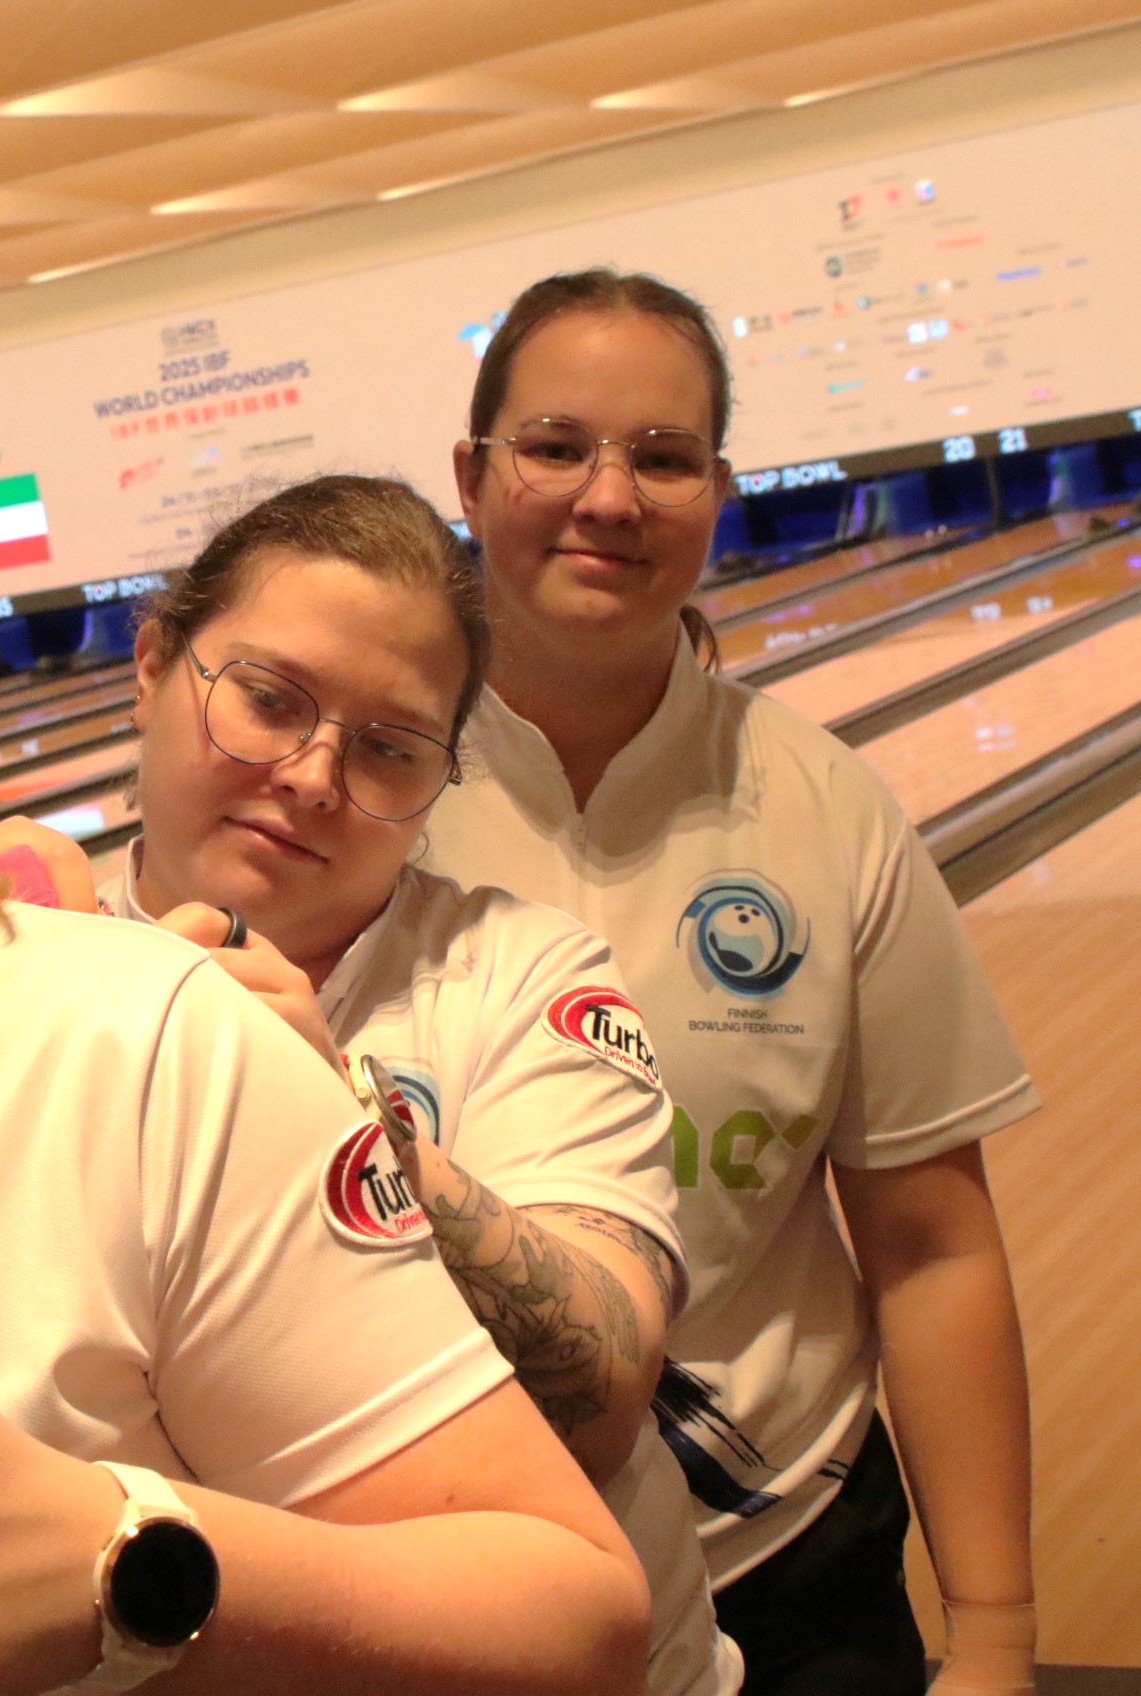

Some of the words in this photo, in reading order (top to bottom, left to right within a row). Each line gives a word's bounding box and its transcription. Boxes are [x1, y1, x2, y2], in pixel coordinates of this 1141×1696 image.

[159, 358, 202, 382] 2025
[93, 388, 159, 418] WORLD
[160, 358, 310, 406] CHAMPIONSHIPS
[943, 434, 977, 464] 20
[998, 426, 1029, 455] 21
[735, 469, 781, 496] TOP
[781, 459, 848, 490] BOWL
[81, 582, 118, 604] TOP
[727, 1007, 768, 1020] FINNISH
[688, 1019, 741, 1034] BOWLING
[742, 1021, 805, 1035] FEDERATION
